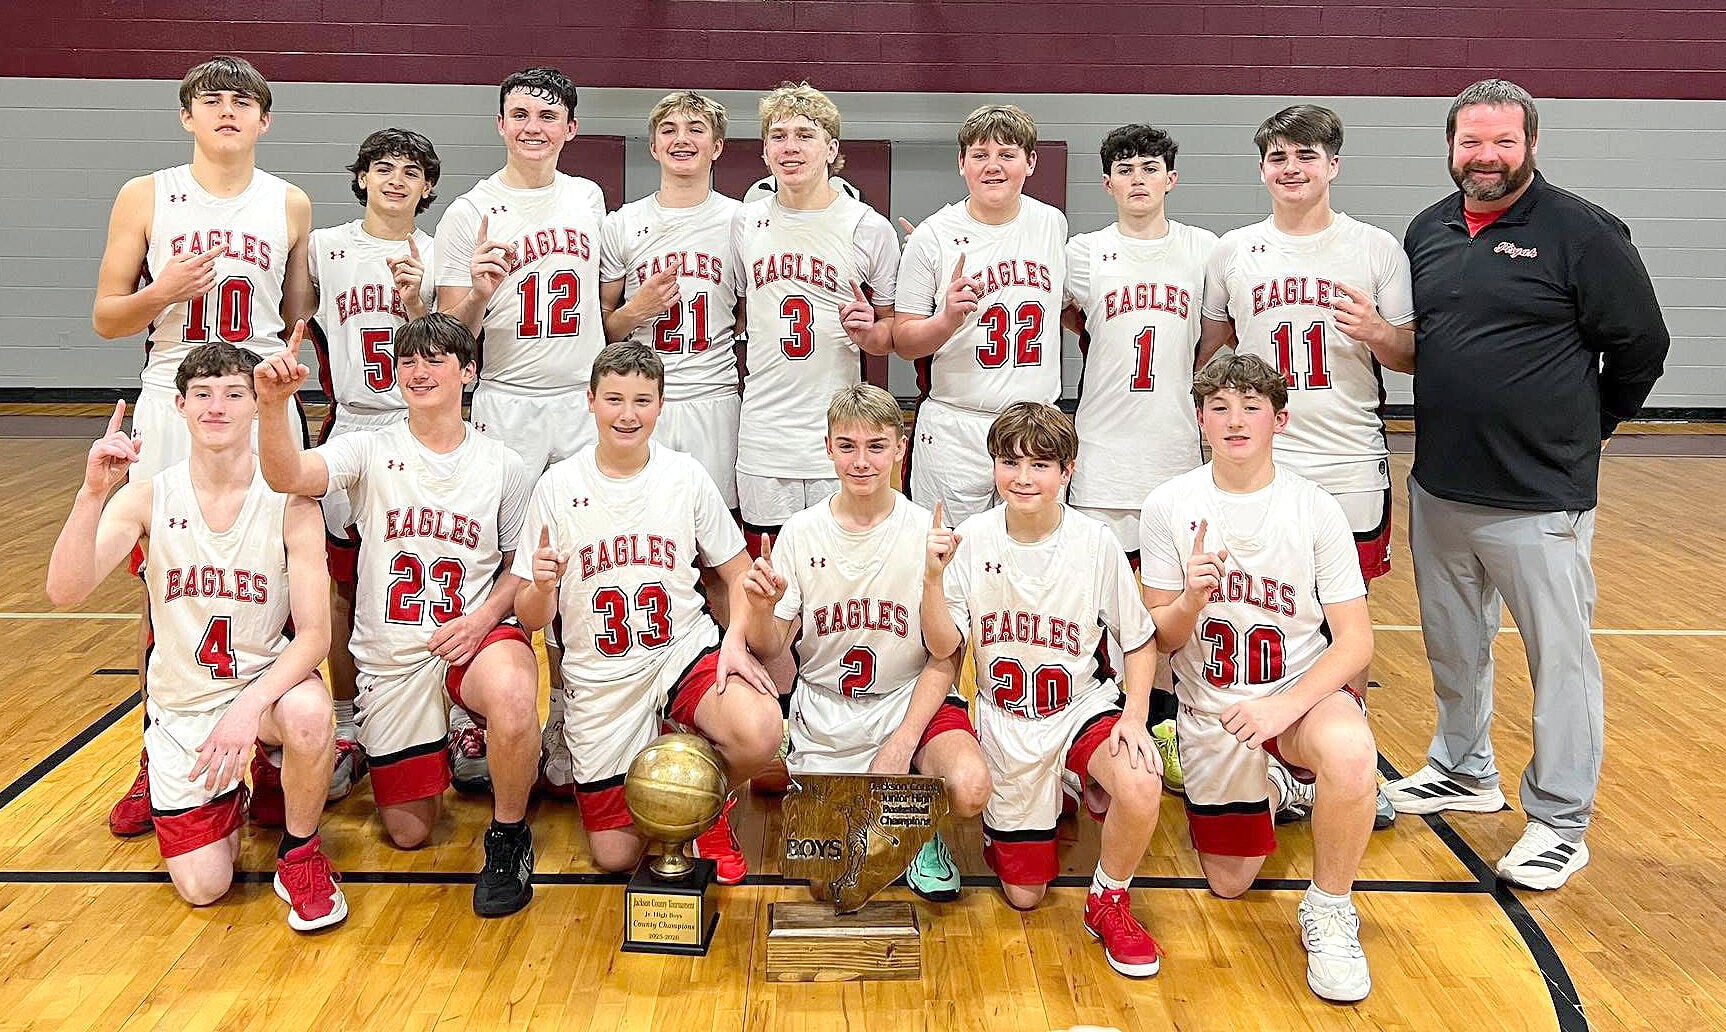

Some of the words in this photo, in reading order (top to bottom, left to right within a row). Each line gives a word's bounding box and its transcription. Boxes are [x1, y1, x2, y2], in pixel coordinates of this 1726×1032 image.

[171, 229, 272, 272] EAGLES
[752, 252, 838, 293] EAGLES
[182, 275, 255, 343] 10
[336, 284, 409, 328] EAGLE
[516, 269, 581, 339] 12
[1105, 282, 1190, 322] EAGLES
[1252, 277, 1342, 317] EAGLE
[652, 291, 713, 354] 21
[780, 294, 815, 361] 3
[975, 301, 1046, 369] 32
[360, 327, 398, 393] 5
[1130, 326, 1156, 392] 1
[1270, 320, 1332, 390] 11
[384, 506, 481, 550] EAGLES
[580, 533, 677, 581] EAGLES
[165, 565, 268, 604] EAGLES
[385, 550, 466, 627] 23
[1205, 570, 1296, 618] AGLES
[592, 581, 674, 658] 33
[813, 598, 909, 638] EAGLES
[981, 610, 1080, 657] EAGLES
[195, 615, 237, 680] 4
[1201, 617, 1286, 688] 30
[839, 645, 877, 698] 2
[990, 656, 1073, 719] 20
[869, 781, 907, 791] Jackson
[909, 782, 942, 793] County
[881, 792, 910, 803] Junior
[911, 793, 932, 804] High
[881, 804, 930, 814] Basketball
[879, 815, 932, 827] Champions
[786, 839, 842, 860] BOYS
[633, 897, 650, 907] Jackson
[651, 898, 667, 909] County
[668, 899, 694, 909] Tournament
[633, 919, 657, 930] County
[658, 920, 695, 931] Champions
[669, 911, 682, 919] Boys
